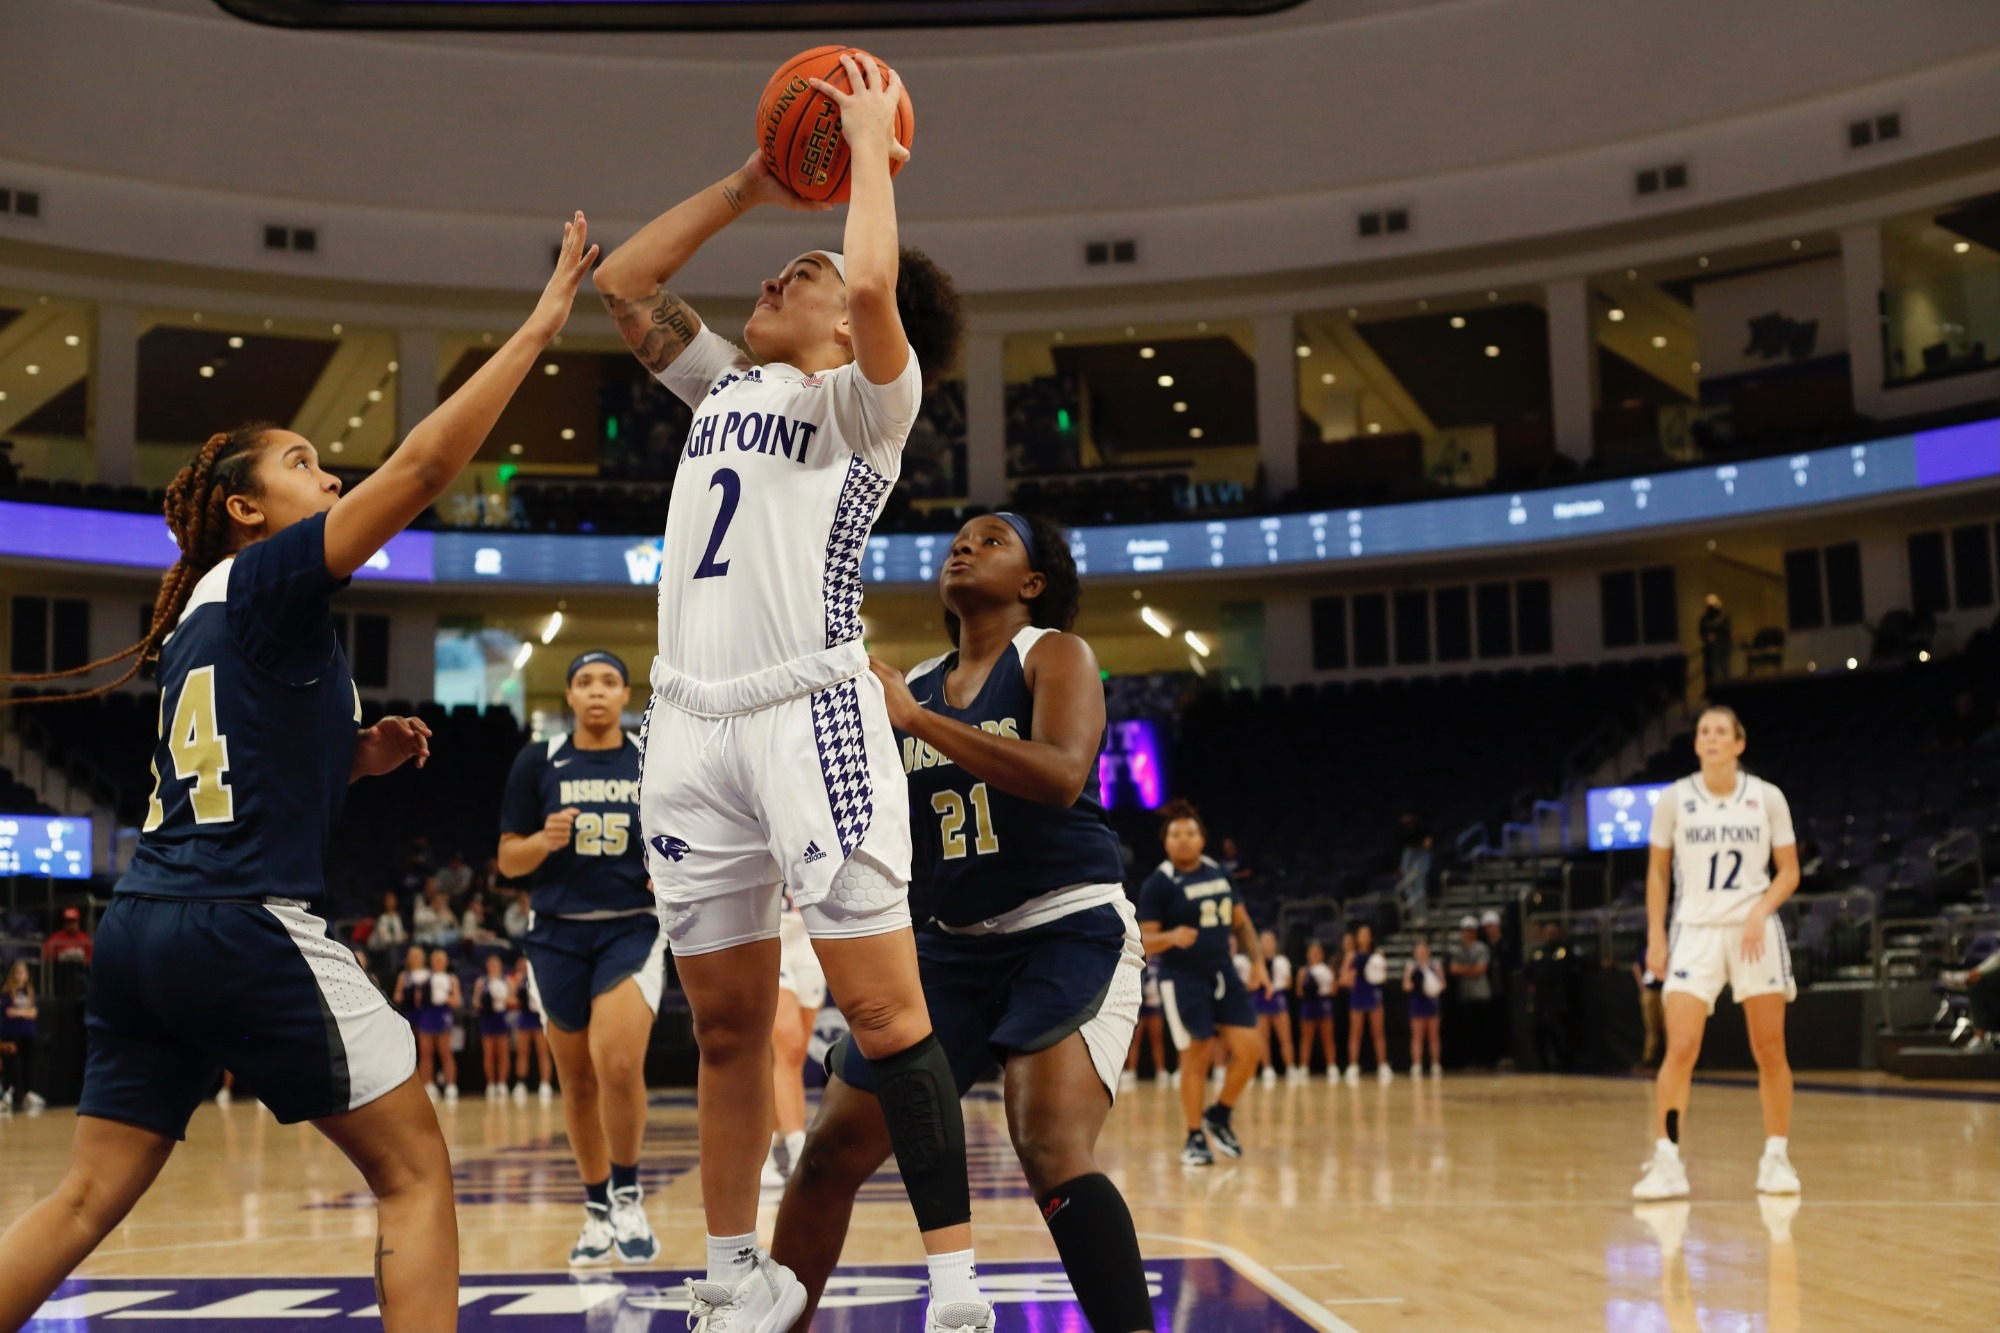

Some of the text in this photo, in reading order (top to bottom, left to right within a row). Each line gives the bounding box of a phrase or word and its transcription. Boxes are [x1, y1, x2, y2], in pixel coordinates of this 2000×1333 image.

[763, 74, 810, 174] SPALDING
[798, 100, 836, 187] LEGACY
[719, 411, 817, 464] POINT
[693, 467, 741, 580] 2
[575, 812, 631, 856] 25
[931, 782, 1000, 860] 21
[1686, 826, 1760, 843] HIGH POINT
[1707, 849, 1743, 890] 12
